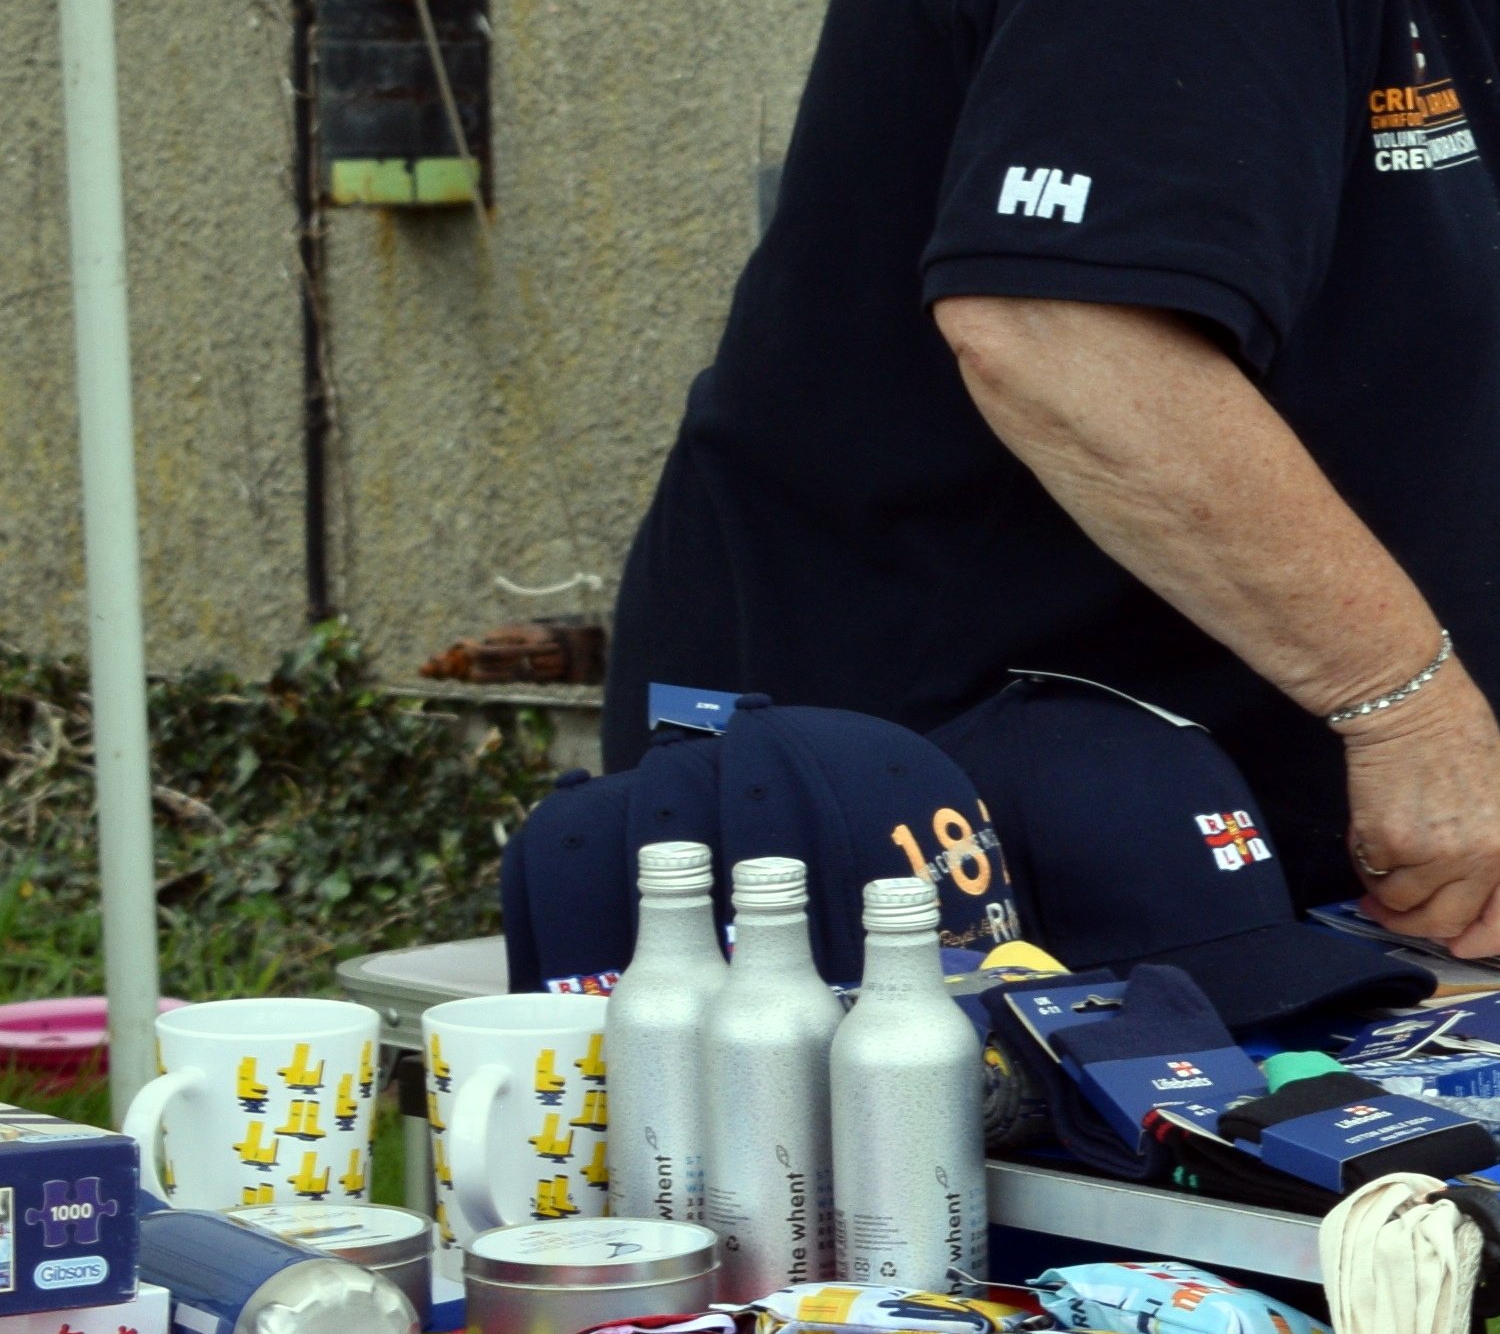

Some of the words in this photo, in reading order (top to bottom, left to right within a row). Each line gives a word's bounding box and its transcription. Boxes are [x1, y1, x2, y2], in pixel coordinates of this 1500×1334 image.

[1369, 87, 1415, 113] CRI
[998, 165, 1092, 224] HH
[50, 1202, 94, 1222] 1000
[654, 1155, 673, 1220] whent
[786, 1171, 807, 1244] whent
[945, 1192, 963, 1263] whent
[41, 1263, 101, 1283] Gibsons
[787, 1246, 807, 1285] the
